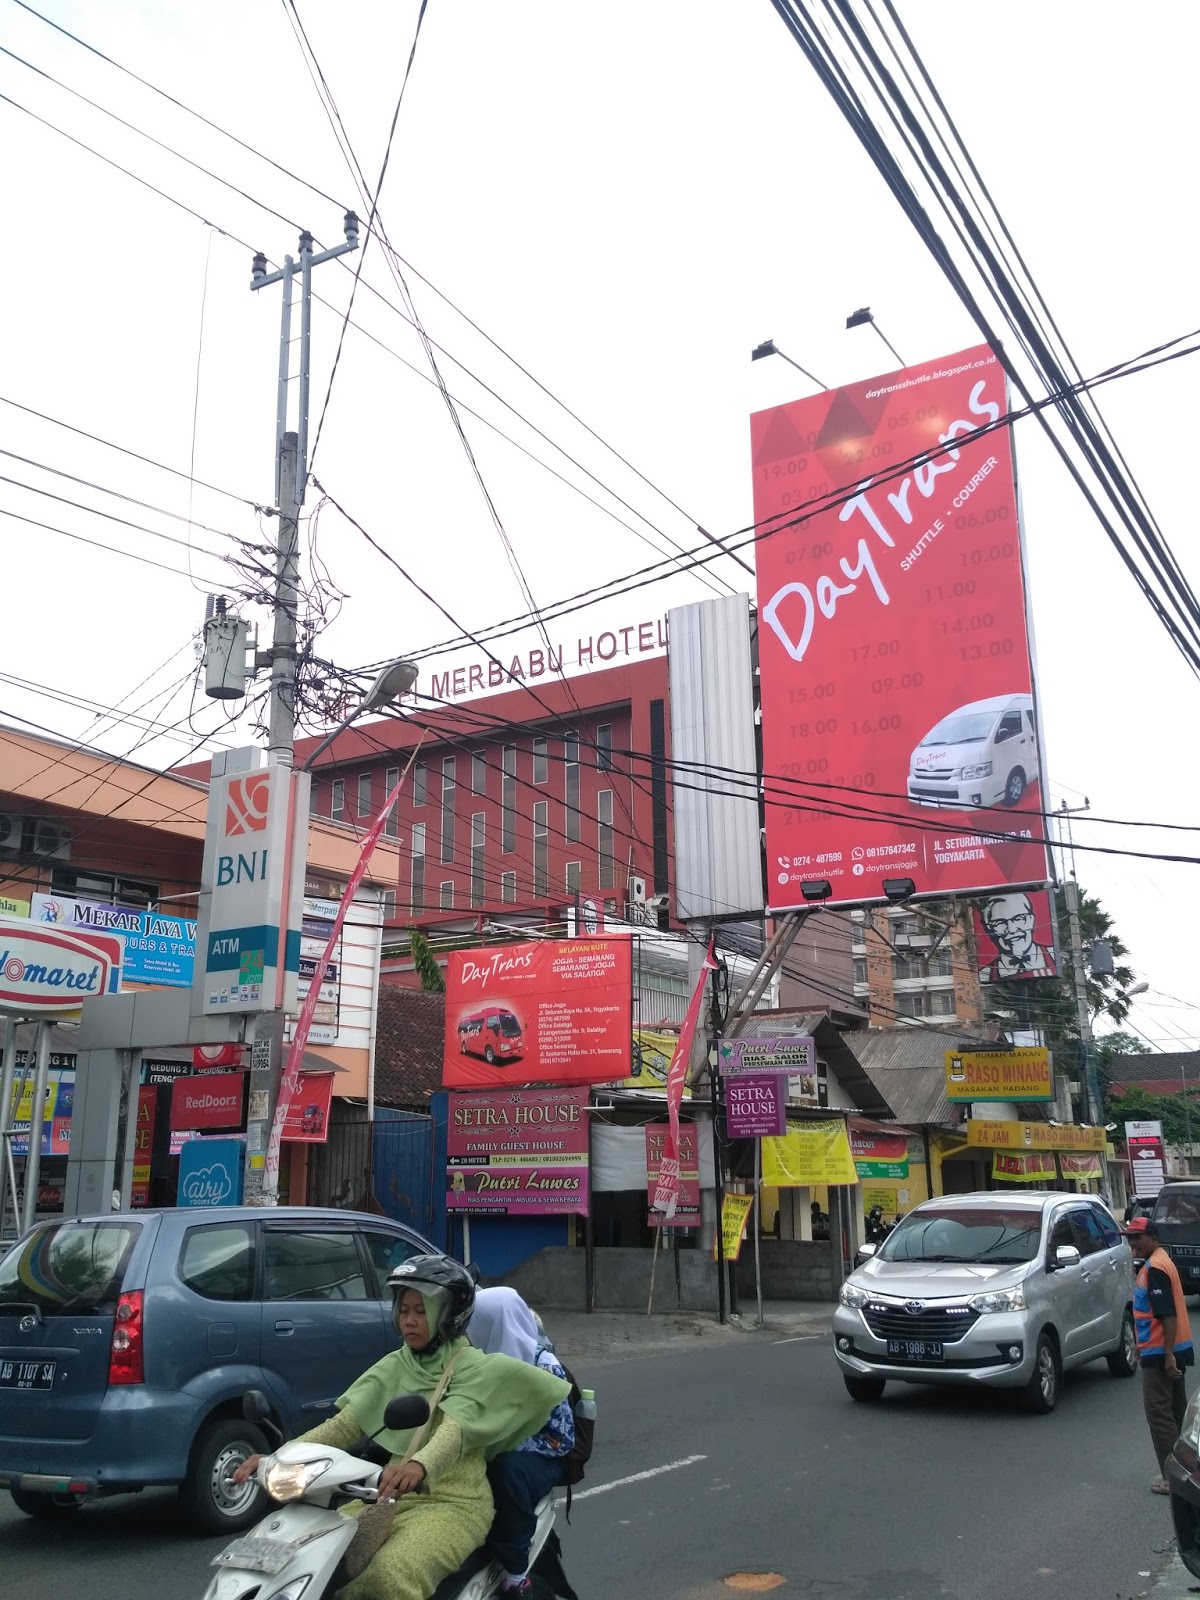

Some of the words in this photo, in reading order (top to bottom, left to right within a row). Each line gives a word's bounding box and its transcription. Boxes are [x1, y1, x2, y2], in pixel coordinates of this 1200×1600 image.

[865, 355, 996, 398] daytransshuttle.blogspot.co.id
[888, 404, 938, 430] 05.00
[762, 459, 807, 480] 19.00
[763, 380, 1000, 661] DayTrans
[900, 519, 945, 571] SHUTTLE
[953, 456, 998, 508] COURIER
[955, 506, 1009, 530] 06.00
[786, 542, 833, 565] 07.00
[961, 543, 1013, 567] 10.00
[924, 580, 977, 604] 11.00
[941, 613, 994, 636] 14.00
[431, 643, 563, 699] MERBABU
[577, 618, 669, 667] HOTEL
[850, 640, 900, 663] 17.00
[960, 639, 1013, 662] 13.00
[872, 672, 924, 695] 09.00
[788, 682, 836, 706] 15.00
[790, 718, 837, 740] 18.00
[851, 714, 901, 737] 16.00
[933, 840, 944, 851] JL.
[945, 836, 982, 850] SETURAN
[793, 856, 811, 867] 0274
[934, 849, 985, 864] YOGYAKARTA
[217, 850, 268, 886] BNI
[790, 868, 844, 881] daytransshuttle
[865, 860, 918, 873] daytransjogja
[73, 904, 141, 931] MEKAR
[144, 916, 182, 938] JAYA
[159, 942, 167, 953] &
[211, 938, 240, 955] ATM
[558, 945, 590, 954] MELAYANI
[590, 943, 608, 951] RUTE
[240, 950, 264, 972] 24
[299, 963, 314, 974] Lion
[552, 958, 574, 966] JOGJA
[578, 954, 615, 964] SEMARANG
[552, 964, 589, 973] SEMARANG
[593, 961, 615, 969] JOGJA
[461, 952, 533, 988] DayTrans
[573, 970, 605, 978] SALATIGA
[593, 1005, 619, 1013] Yogyakarta
[736, 1041, 770, 1056] Putri
[773, 1040, 811, 1053] Luwes
[151, 1064, 181, 1073] GEDUNG
[182, 1066, 188, 1074] 2
[966, 1063, 1000, 1084] RASO
[1002, 1060, 1049, 1083] MINANG
[150, 1074, 174, 1083] (TENG
[185, 1095, 237, 1109] RedDoorz
[730, 1087, 775, 1101] SETRA
[454, 1106, 509, 1126] SETRA
[514, 1104, 580, 1124] HOUSE
[731, 1101, 776, 1115] HOUSE
[977, 1130, 989, 1142] 24
[991, 1130, 1009, 1143] JAM
[1034, 1128, 1058, 1141] RASO
[1059, 1129, 1090, 1143] MINANG
[467, 1143, 499, 1151] FAMILY
[500, 1142, 530, 1150] GUEST
[532, 1141, 565, 1149] HOUSE
[650, 1149, 694, 1160] HSE
[467, 1156, 487, 1164] METER
[188, 1175, 224, 1204] airy
[473, 1171, 520, 1194] Putri
[525, 1170, 580, 1189] Luwes
[889, 1341, 900, 1353] AB
[905, 1342, 925, 1354] 1986
[931, 1343, 941, 1355] JJ
[1, 1363, 13, 1379] AB
[18, 1363, 39, 1380] 1107
[42, 1364, 53, 1380] SA
